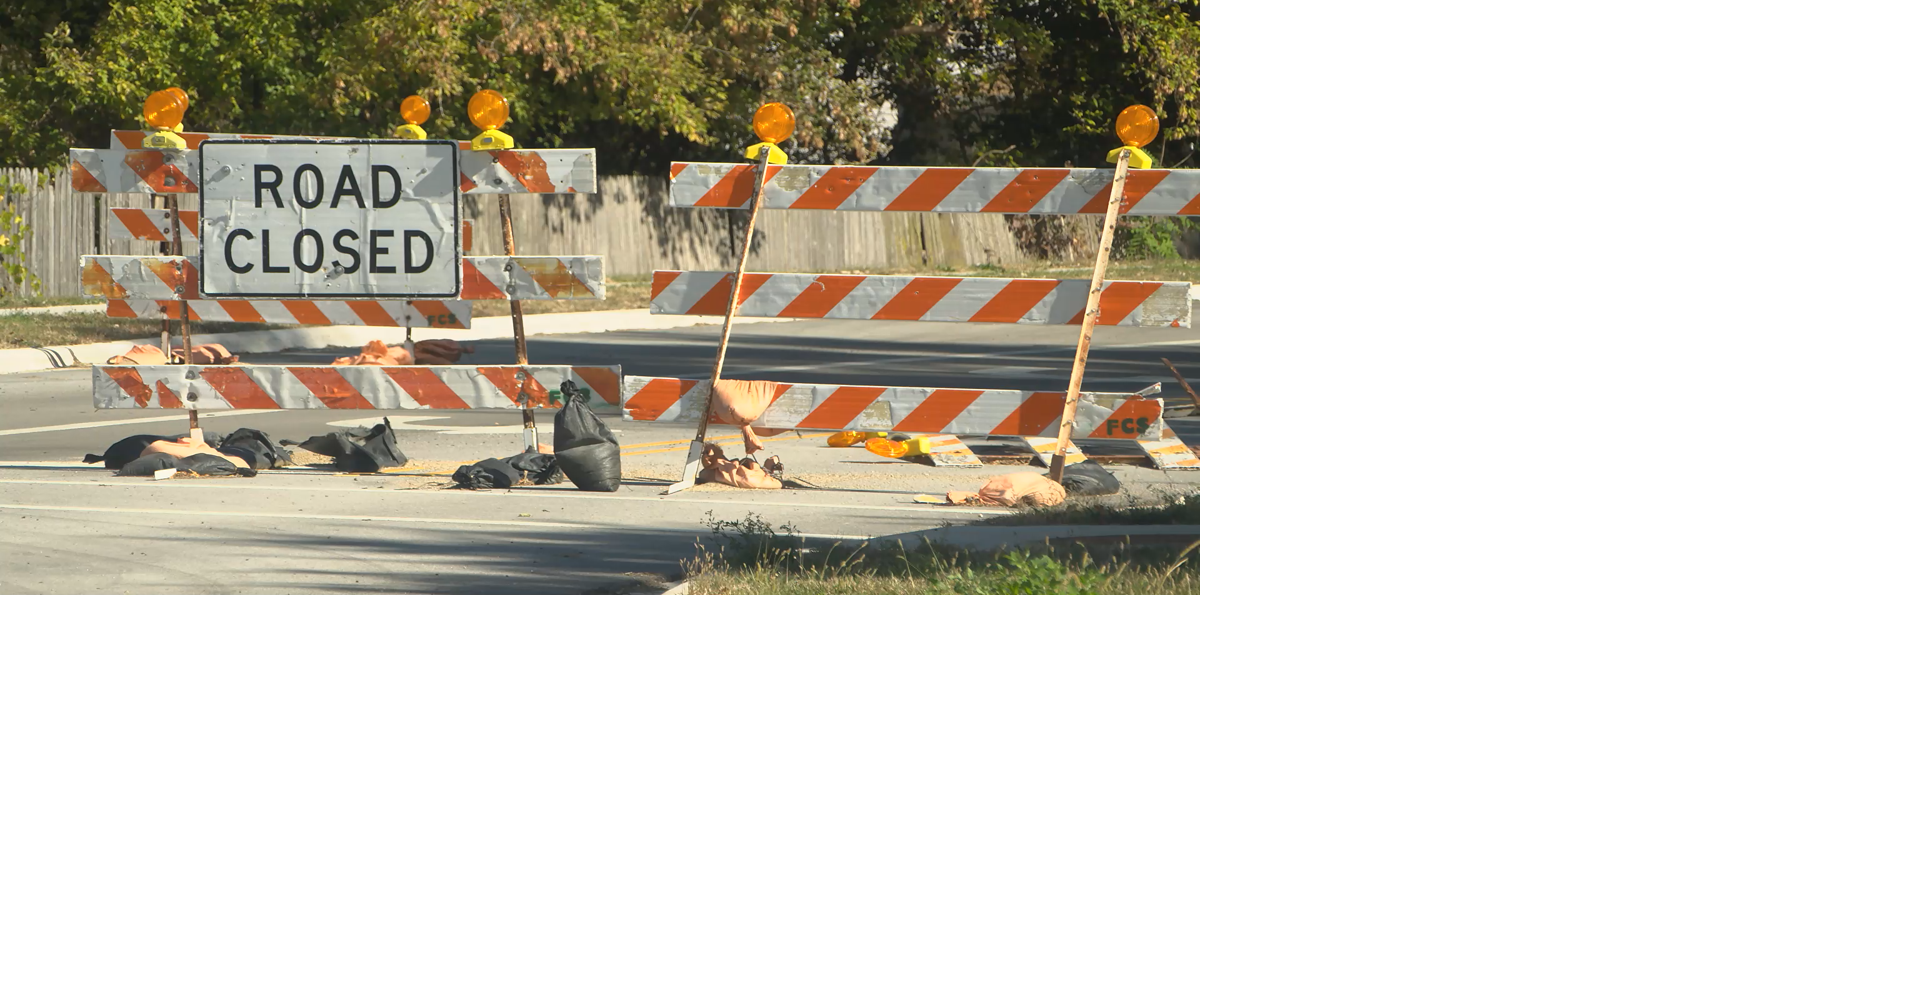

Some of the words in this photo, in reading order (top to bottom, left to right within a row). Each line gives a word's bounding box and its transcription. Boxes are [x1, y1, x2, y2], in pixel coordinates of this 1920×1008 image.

[254, 163, 402, 209] ROAD
[224, 228, 434, 274] CLOSED
[427, 313, 457, 326] FCS
[549, 387, 592, 405] FS
[1106, 417, 1149, 436] FCS
